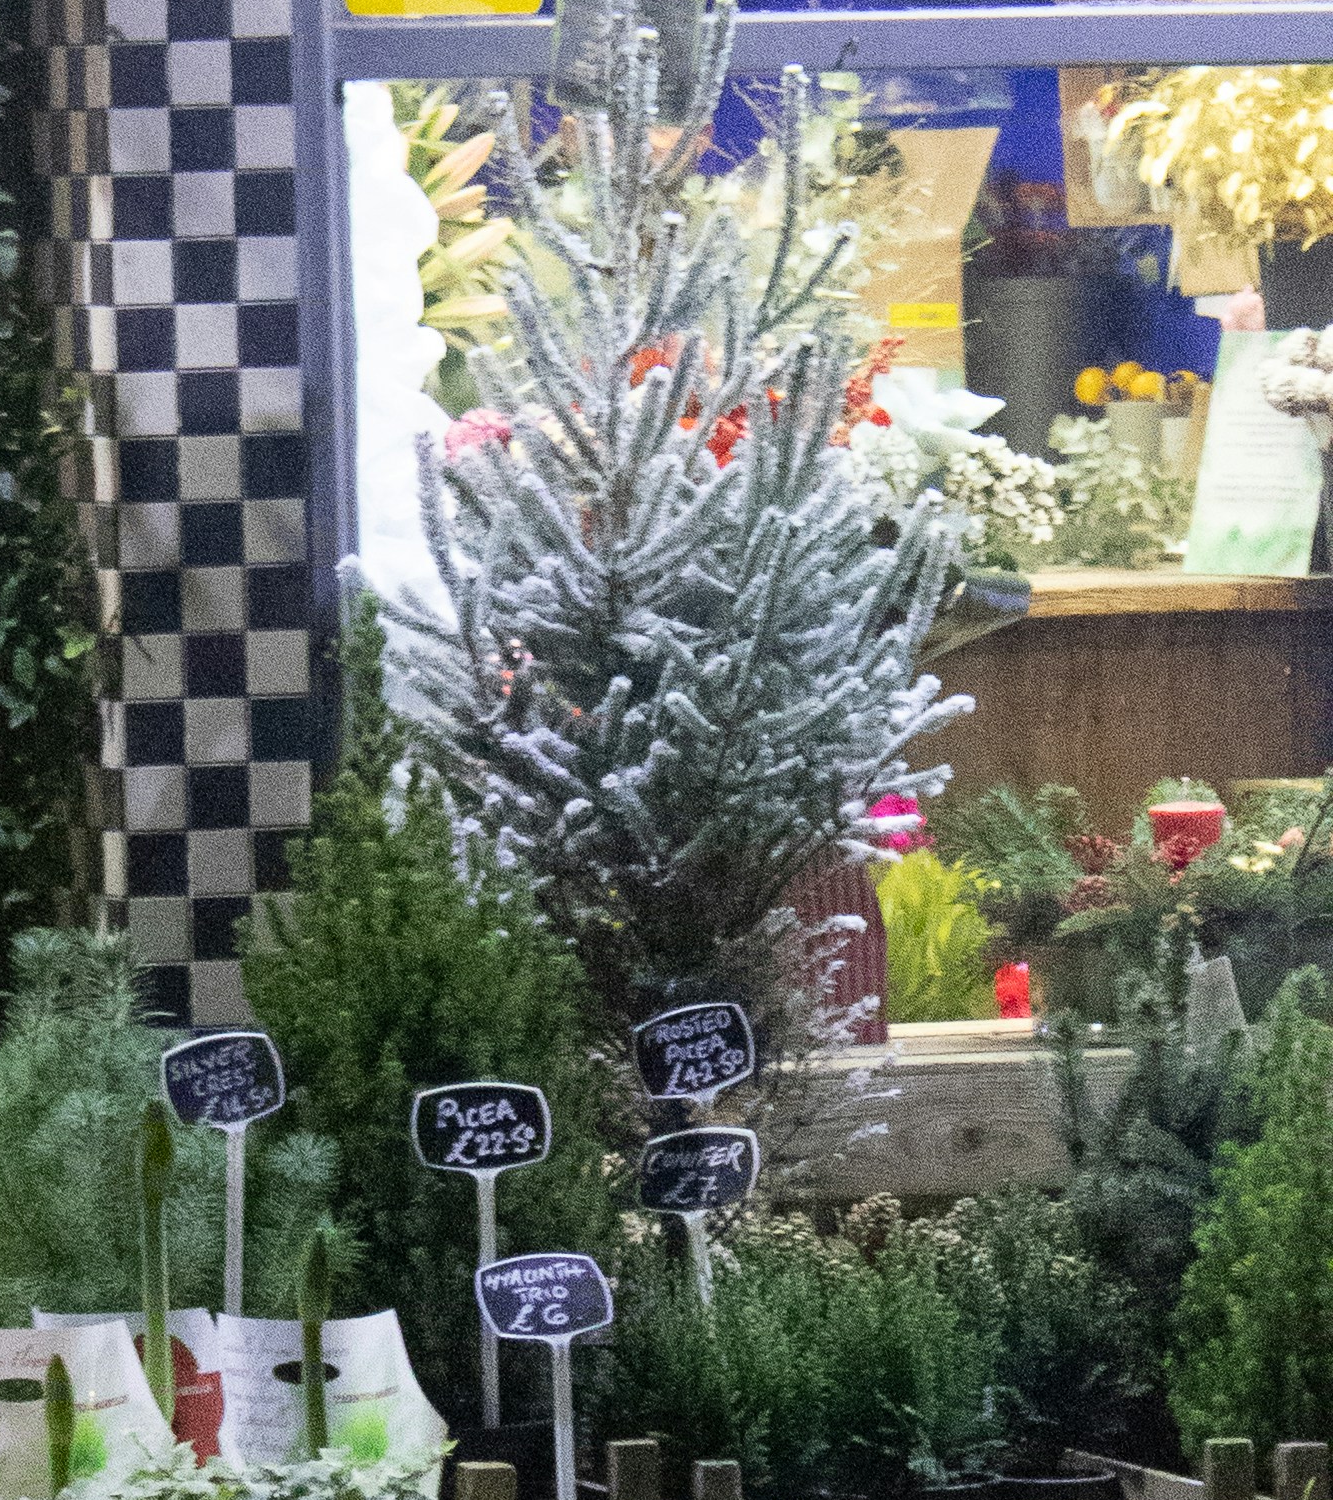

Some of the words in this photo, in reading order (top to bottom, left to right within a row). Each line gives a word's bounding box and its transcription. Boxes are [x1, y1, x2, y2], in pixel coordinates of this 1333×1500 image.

[170, 1040, 252, 1082] SILVER
[665, 1033, 726, 1065] PICEA
[436, 1098, 518, 1129] PICEA
[646, 1141, 745, 1175] CONIFER
[512, 1285, 570, 1304] TRIO
